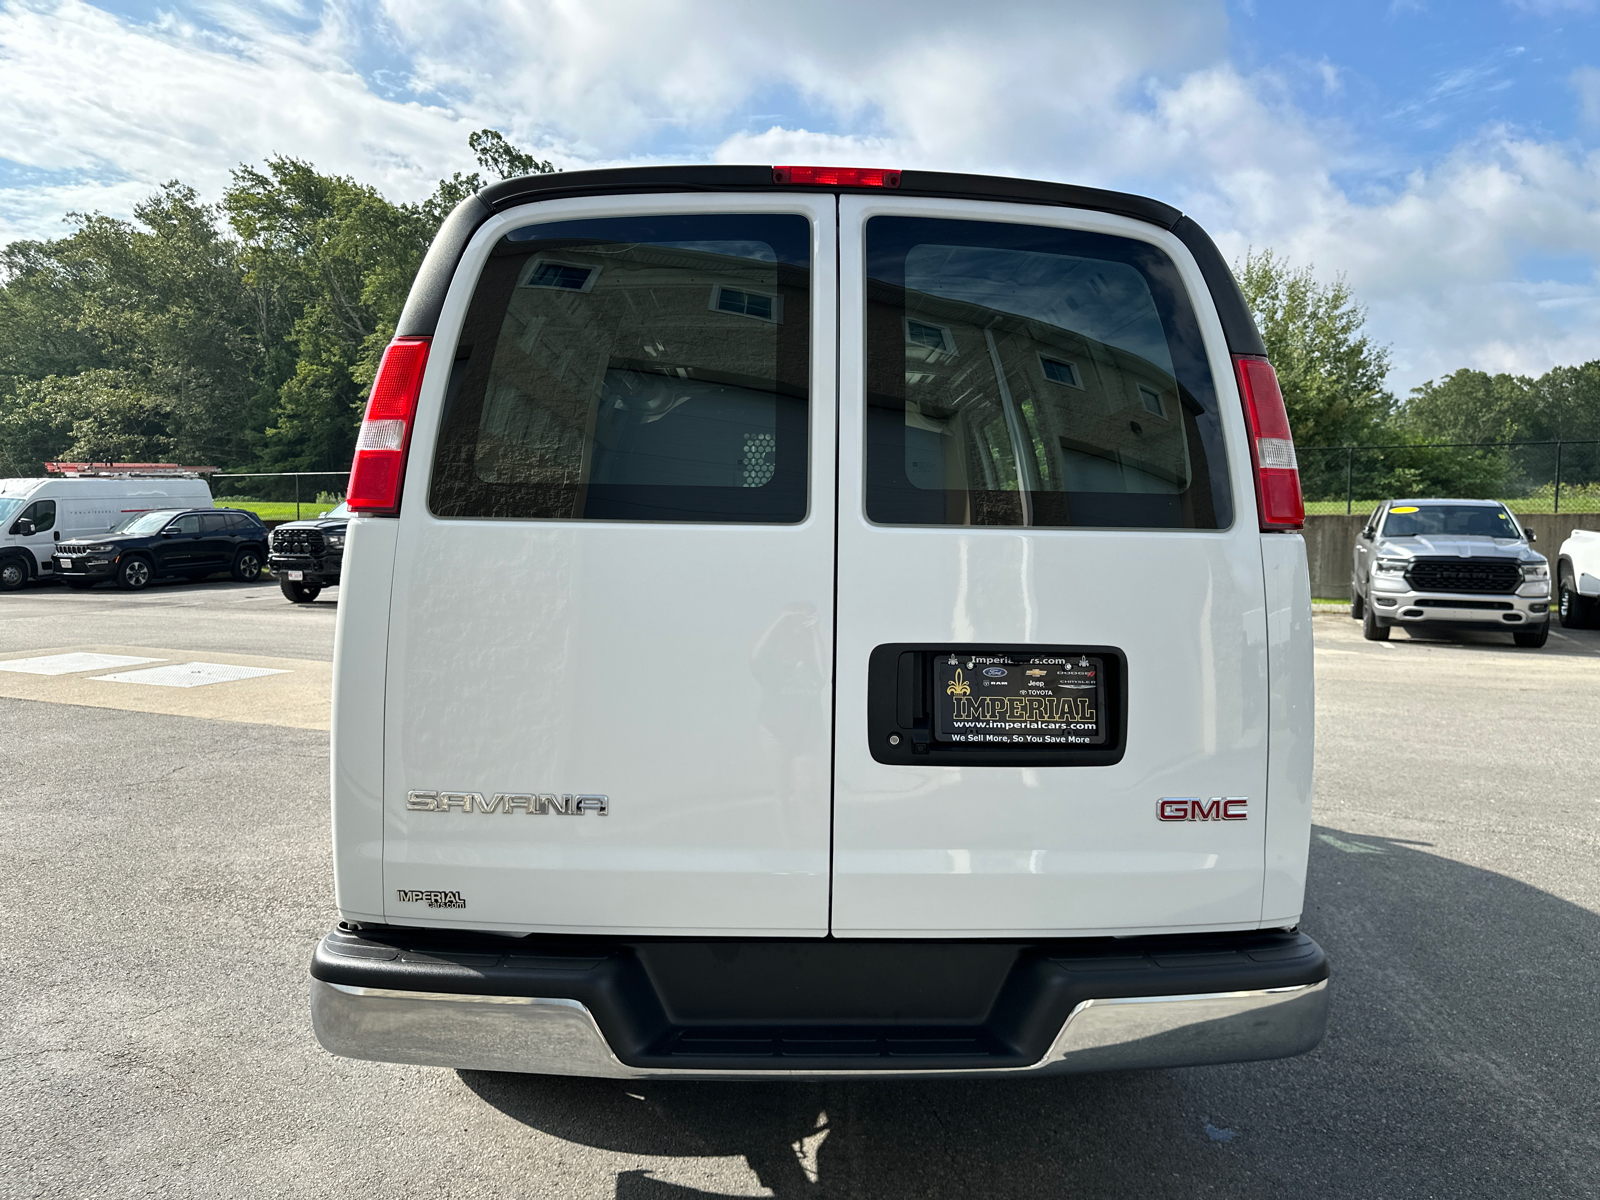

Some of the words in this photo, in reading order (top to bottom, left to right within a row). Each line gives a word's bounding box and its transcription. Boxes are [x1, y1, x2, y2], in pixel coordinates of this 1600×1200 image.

[1028, 680, 1045, 688] Jeep
[953, 696, 1096, 722] IMPERIAL
[953, 720, 1096, 730] www.imperialcars.com
[951, 734, 966, 742] We
[967, 734, 984, 742] Sell
[986, 735, 1011, 743] More,
[1012, 735, 1024, 743] So
[1026, 735, 1043, 743] You
[1044, 735, 1066, 743] Save
[1068, 735, 1090, 744] More
[406, 789, 609, 816] SAVANA
[1156, 796, 1248, 821] GMC
[397, 889, 466, 903] IMPERIAL
[427, 901, 466, 909] cars.com
